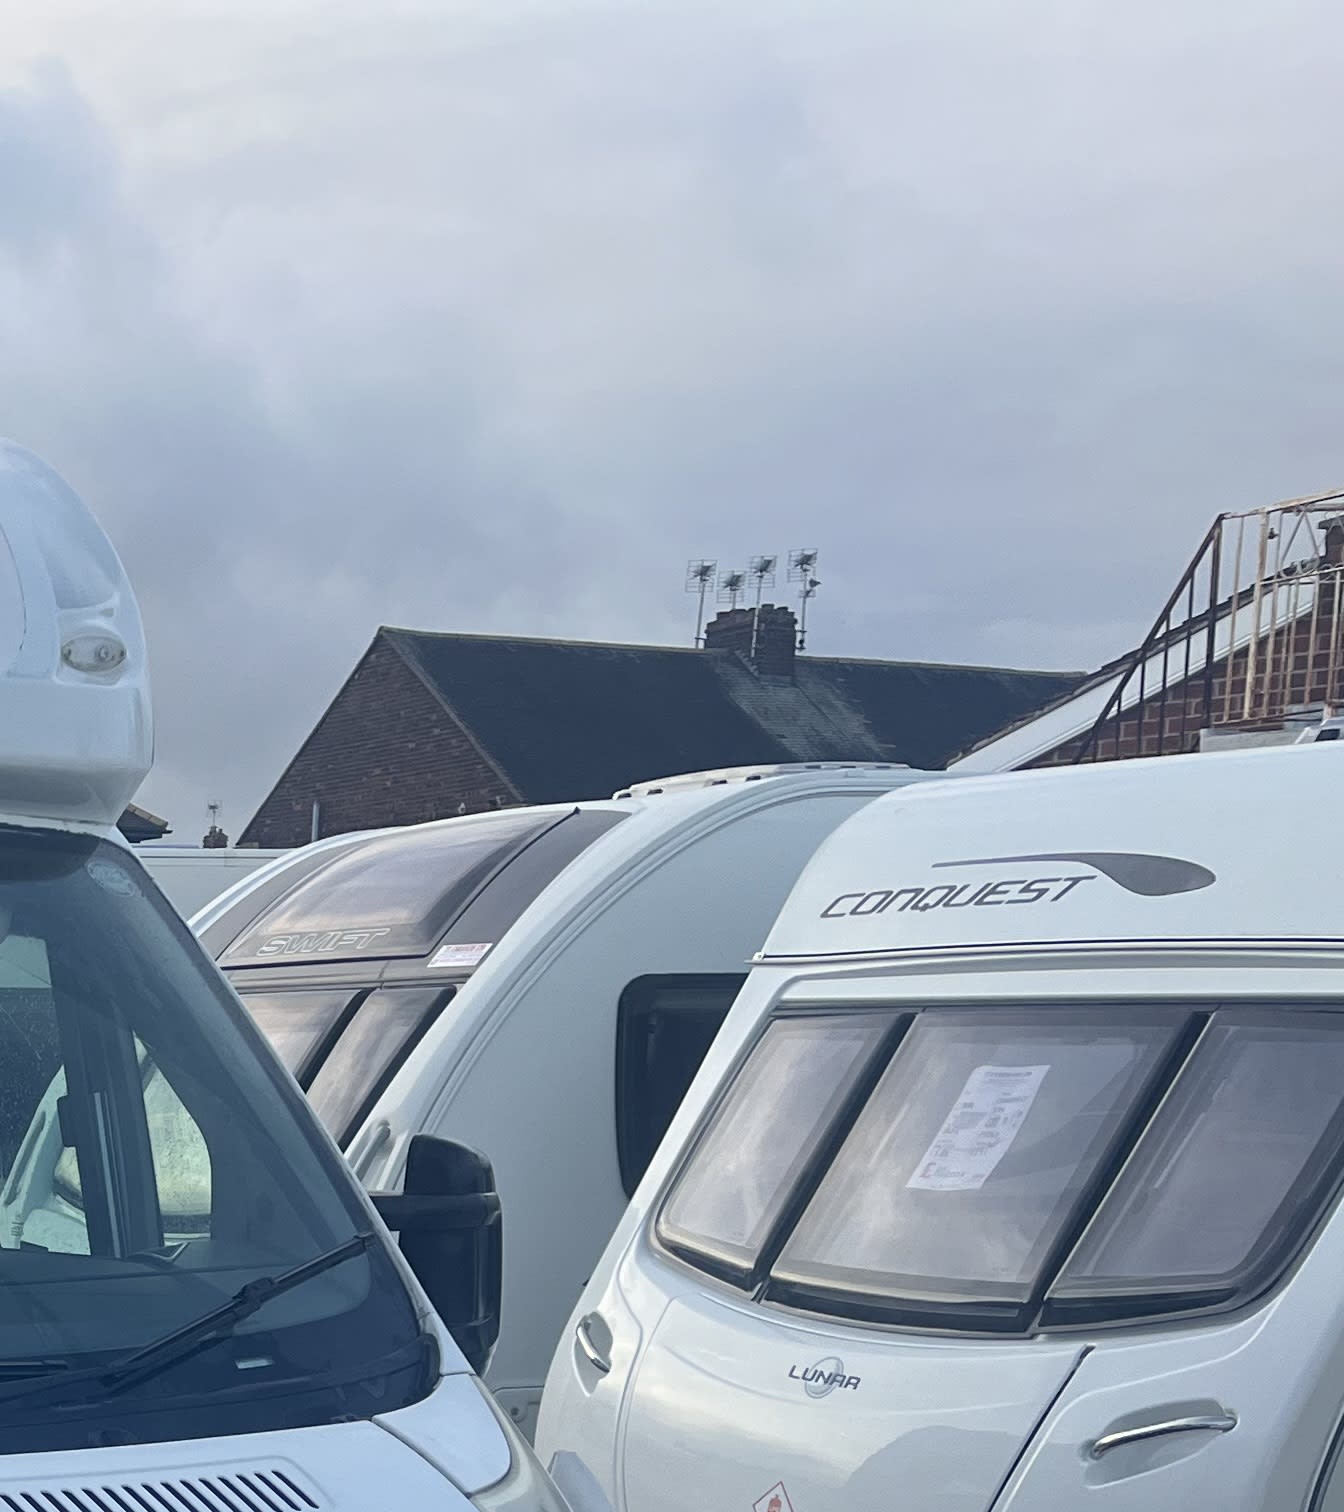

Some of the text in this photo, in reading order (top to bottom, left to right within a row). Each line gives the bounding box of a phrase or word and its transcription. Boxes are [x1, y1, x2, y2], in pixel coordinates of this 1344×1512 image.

[819, 874, 1099, 919] CONQUEST
[256, 926, 392, 957] SWIFT
[788, 1364, 862, 1390] LUNAR
